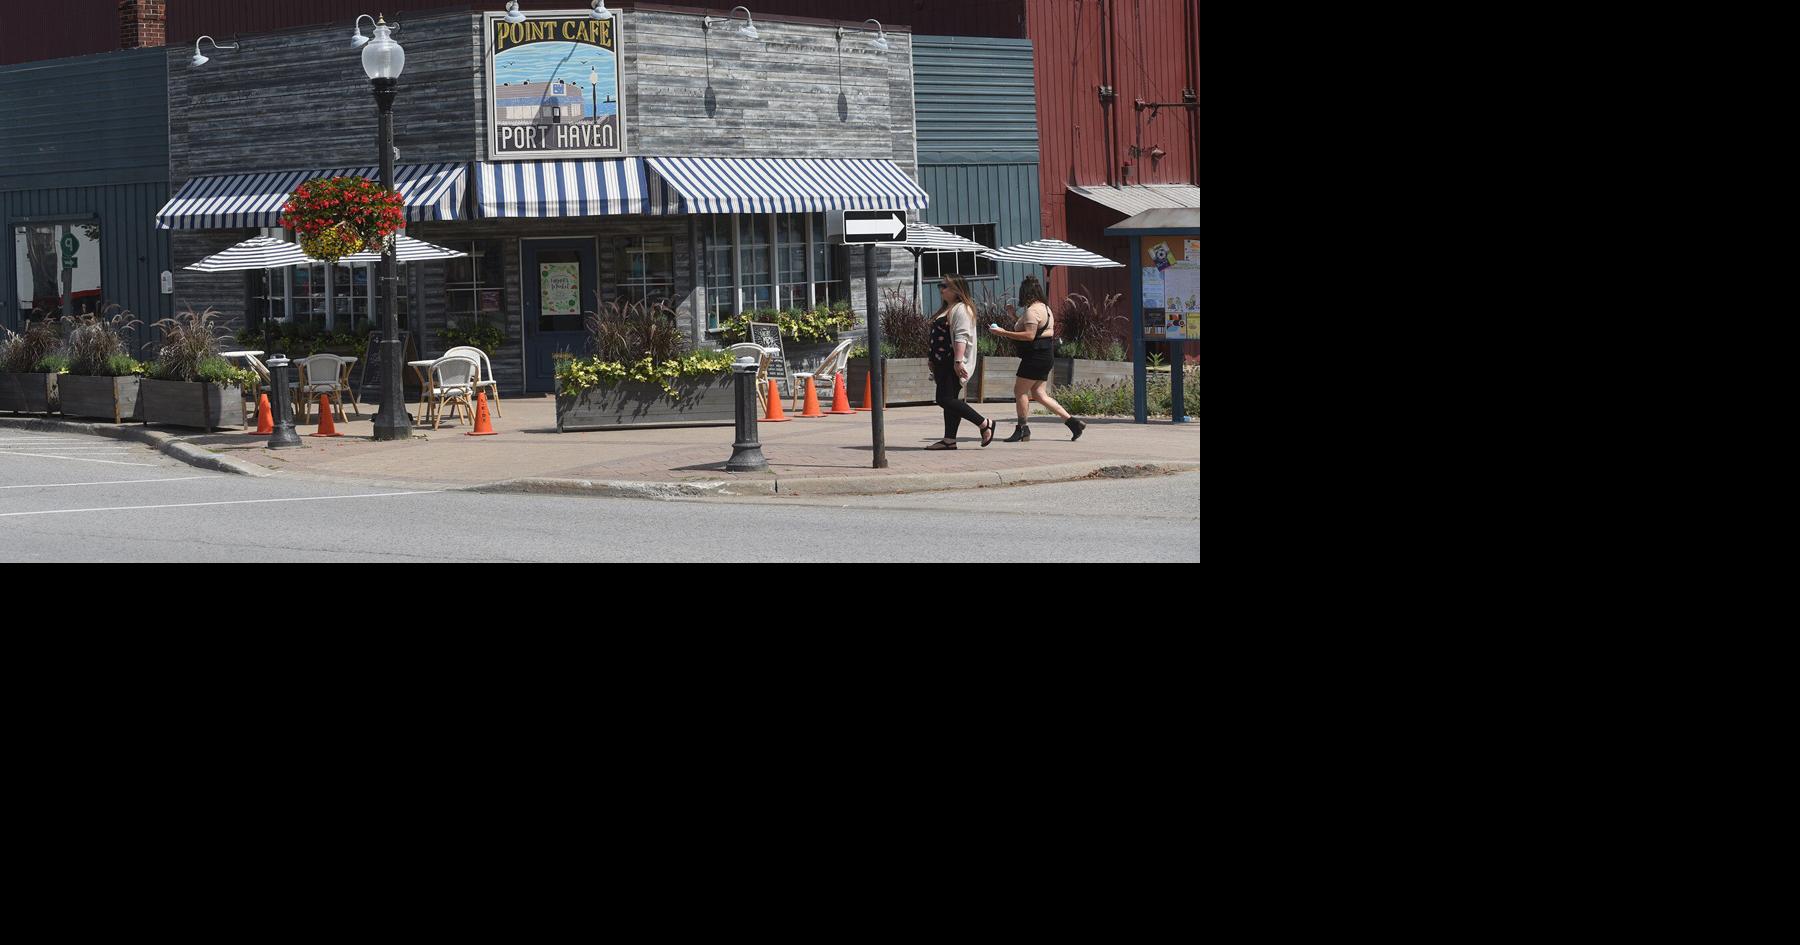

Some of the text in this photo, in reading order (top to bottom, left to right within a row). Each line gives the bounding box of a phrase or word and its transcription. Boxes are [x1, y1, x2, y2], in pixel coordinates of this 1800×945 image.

[497, 20, 612, 50] POINT CAFE
[502, 124, 613, 149] PORT HAVEN
